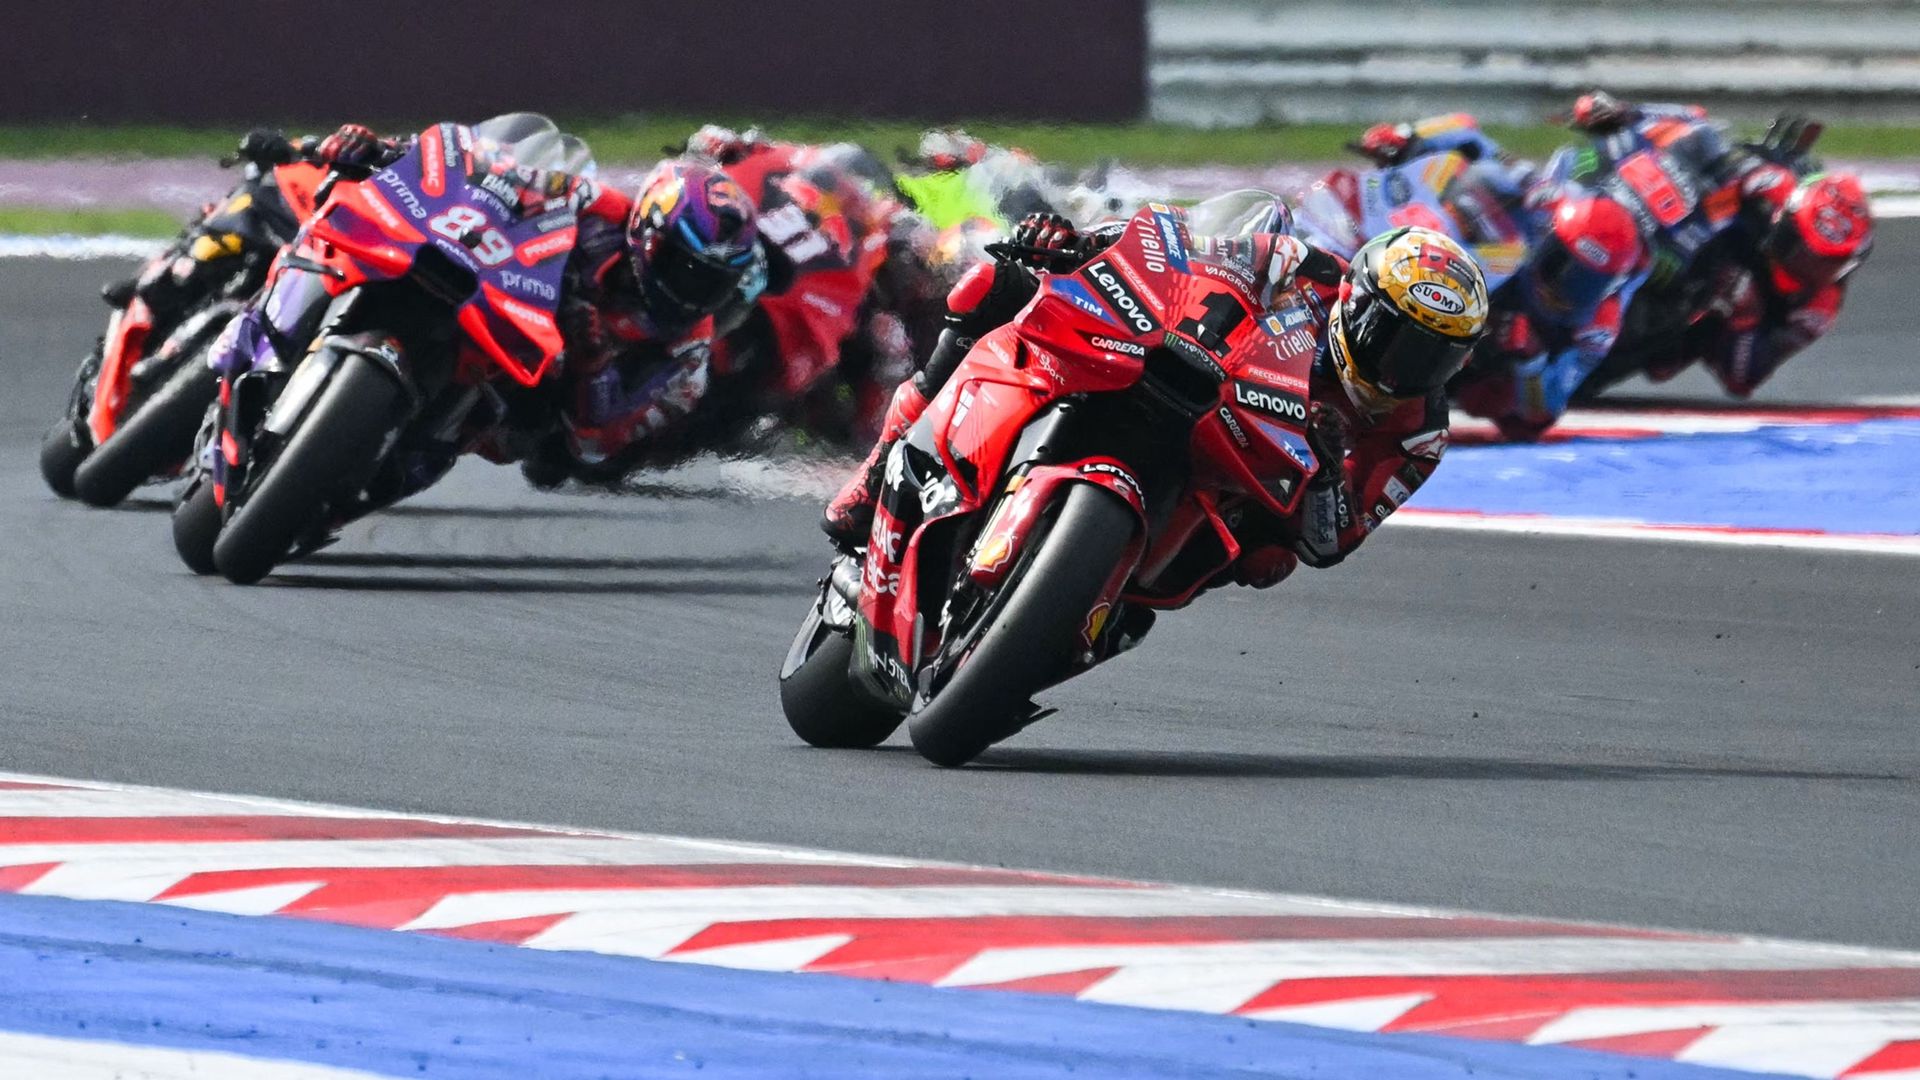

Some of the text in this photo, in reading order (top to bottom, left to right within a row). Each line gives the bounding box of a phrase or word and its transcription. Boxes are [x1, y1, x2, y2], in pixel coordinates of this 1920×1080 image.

[377, 168, 427, 219] prima
[430, 205, 514, 266] 89
[500, 269, 556, 302] prima
[1087, 260, 1153, 333] Lenovo
[1414, 284, 1462, 312] SUOMY
[1074, 295, 1104, 317] TIM
[1174, 291, 1248, 360] 1
[1090, 336, 1145, 357] CARRERA
[1248, 366, 1309, 389] FRECCIAROSSA
[1235, 382, 1306, 420] Lenovo
[1219, 406, 1249, 449] CARRERA
